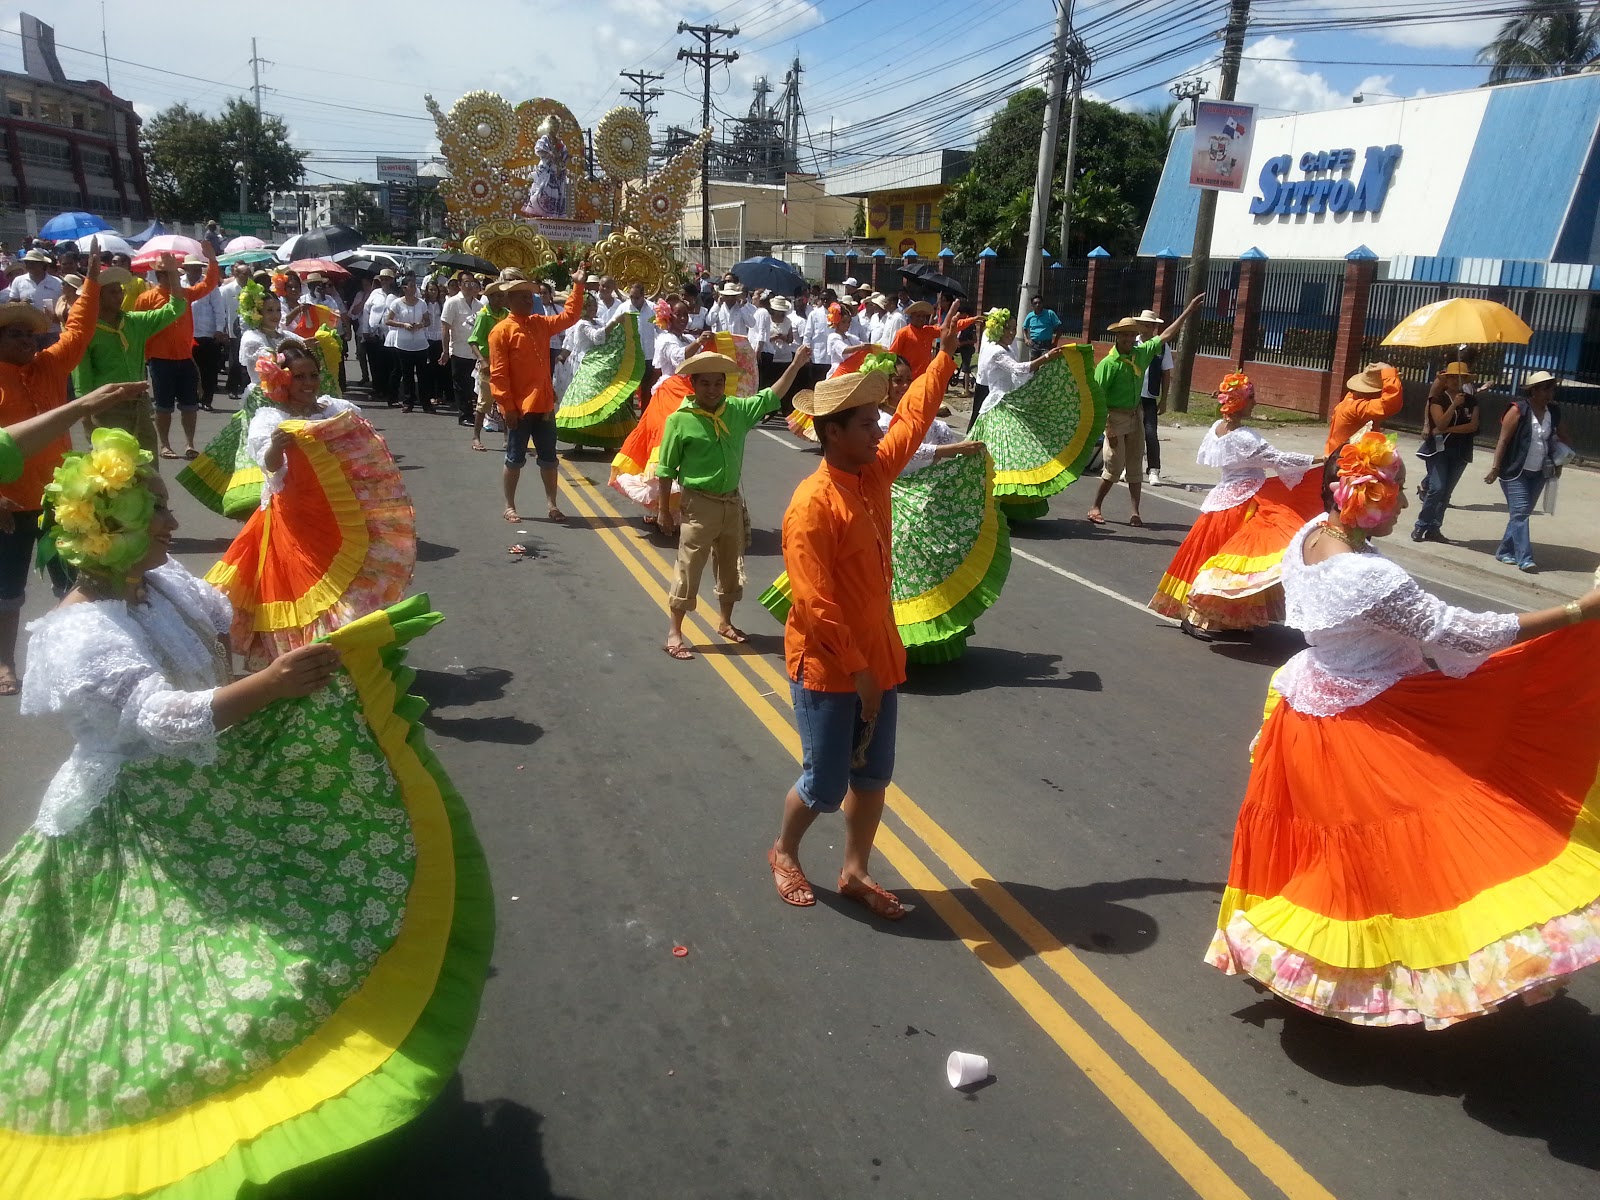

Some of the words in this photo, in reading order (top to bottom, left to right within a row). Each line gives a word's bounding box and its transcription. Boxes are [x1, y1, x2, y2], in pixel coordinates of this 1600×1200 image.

[1299, 148, 1356, 172] CAFE
[1249, 144, 1403, 215] SITTON
[539, 223, 571, 231] Trabajando
